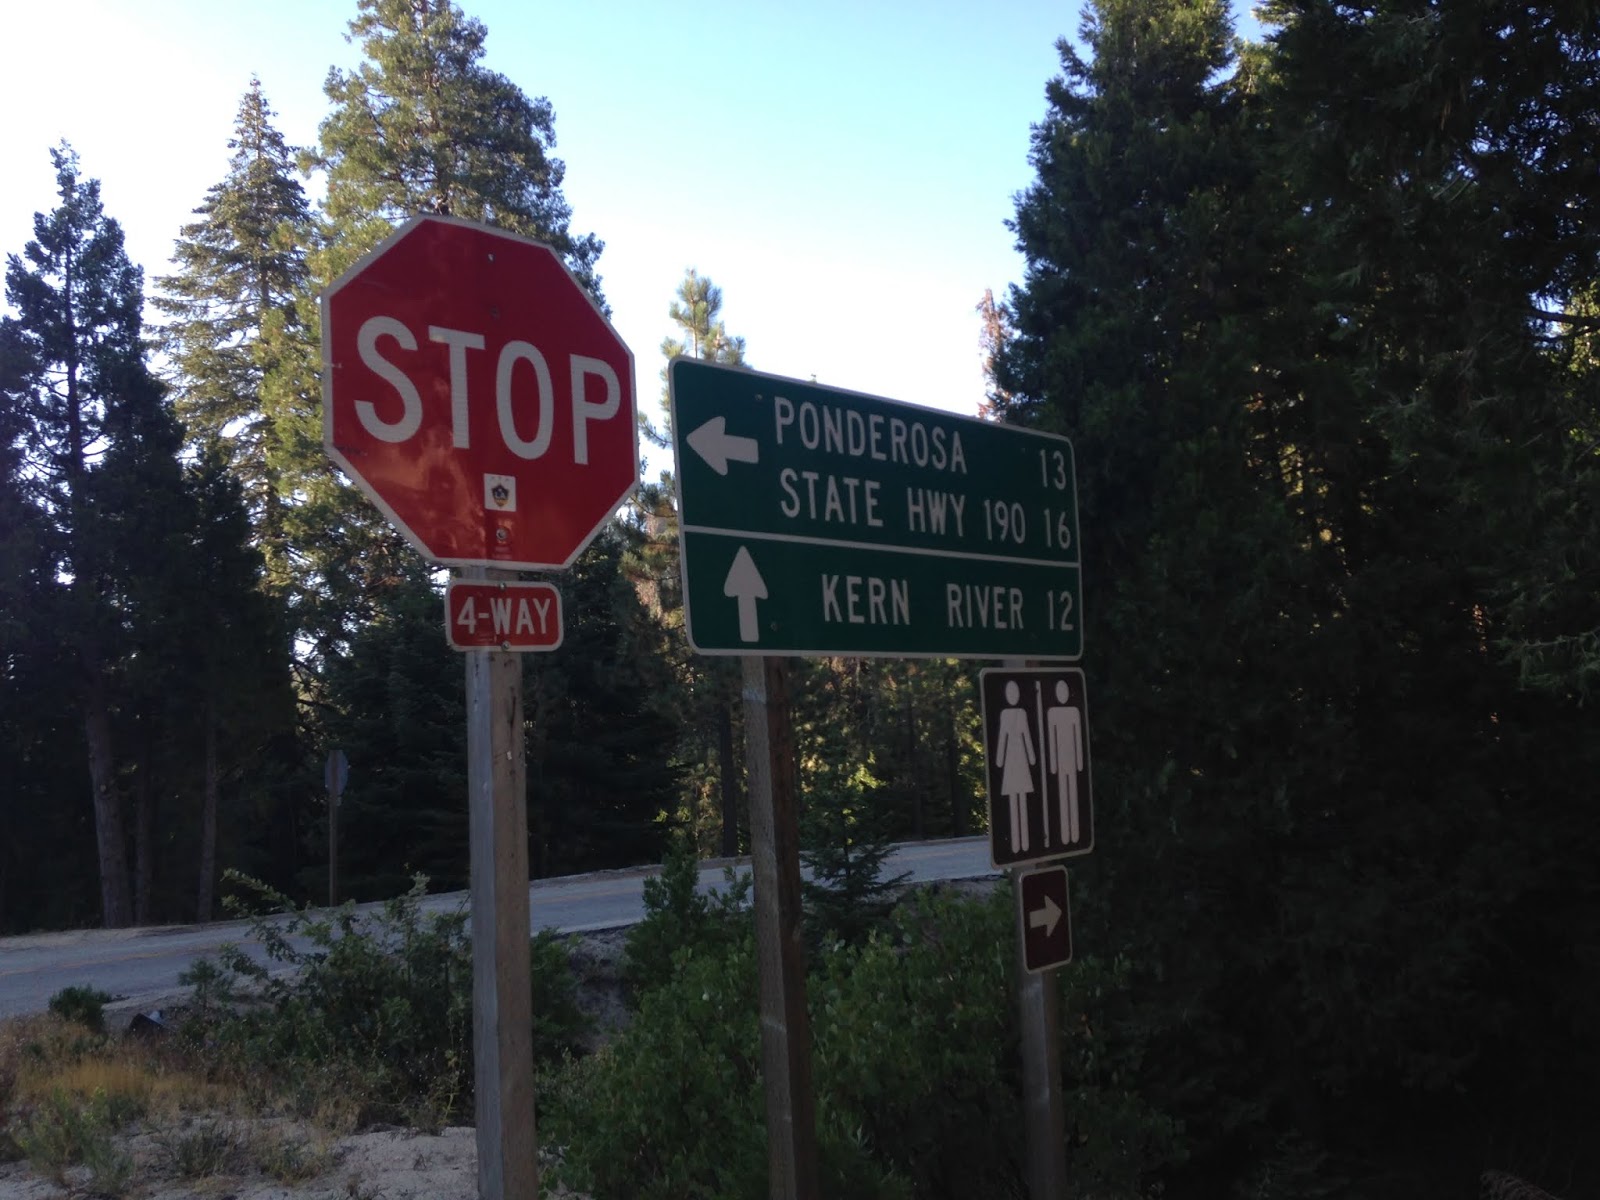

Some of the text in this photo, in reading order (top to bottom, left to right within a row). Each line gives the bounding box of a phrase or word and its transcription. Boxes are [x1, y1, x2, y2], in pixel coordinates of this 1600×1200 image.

[354, 315, 621, 465] STOP
[774, 396, 1067, 490] PONDEROSA 13
[780, 468, 1071, 549] STATE HWY 190 16
[457, 596, 551, 635] 4-WAY
[821, 574, 1074, 631] KERN RIVER 12
